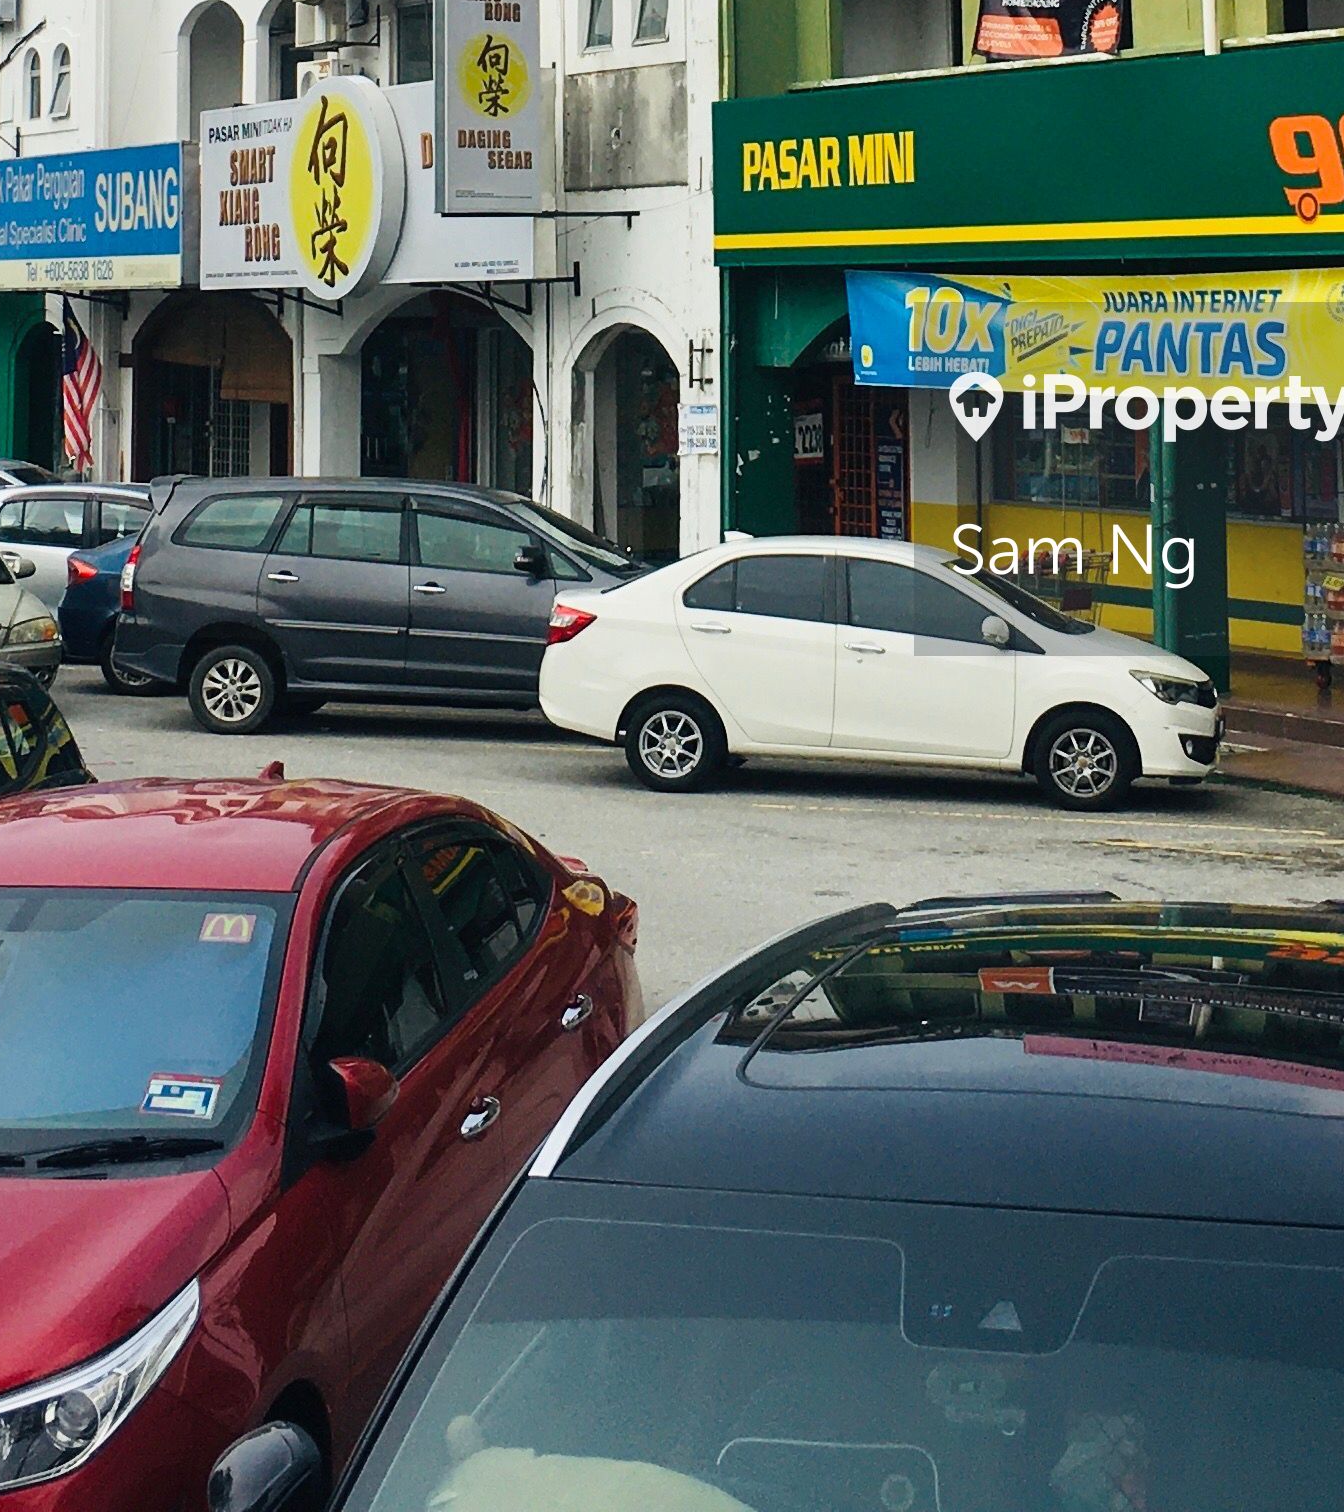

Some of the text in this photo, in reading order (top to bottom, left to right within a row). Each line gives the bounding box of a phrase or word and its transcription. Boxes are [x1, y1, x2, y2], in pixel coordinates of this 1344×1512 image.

[484, 2, 521, 22] RONG
[208, 124, 240, 144] PASAR
[457, 129, 511, 149] DAGING
[230, 146, 276, 187] SMART
[487, 151, 533, 170] SEGAR
[743, 130, 915, 192] PASAR MINI
[6, 166, 34, 203] Pakar
[37, 161, 85, 210] Pergigian
[94, 167, 179, 233] SUBANG
[219, 187, 260, 227] XIANG
[9, 218, 57, 249] Specialist
[58, 217, 86, 243] Clinic
[244, 223, 281, 263] RONG
[92, 260, 114, 281] 1628
[1103, 289, 1282, 314] JUARA INTERNET
[1093, 320, 1286, 378] PANTAS
[908, 355, 989, 374] LEBIH HEBAT!
